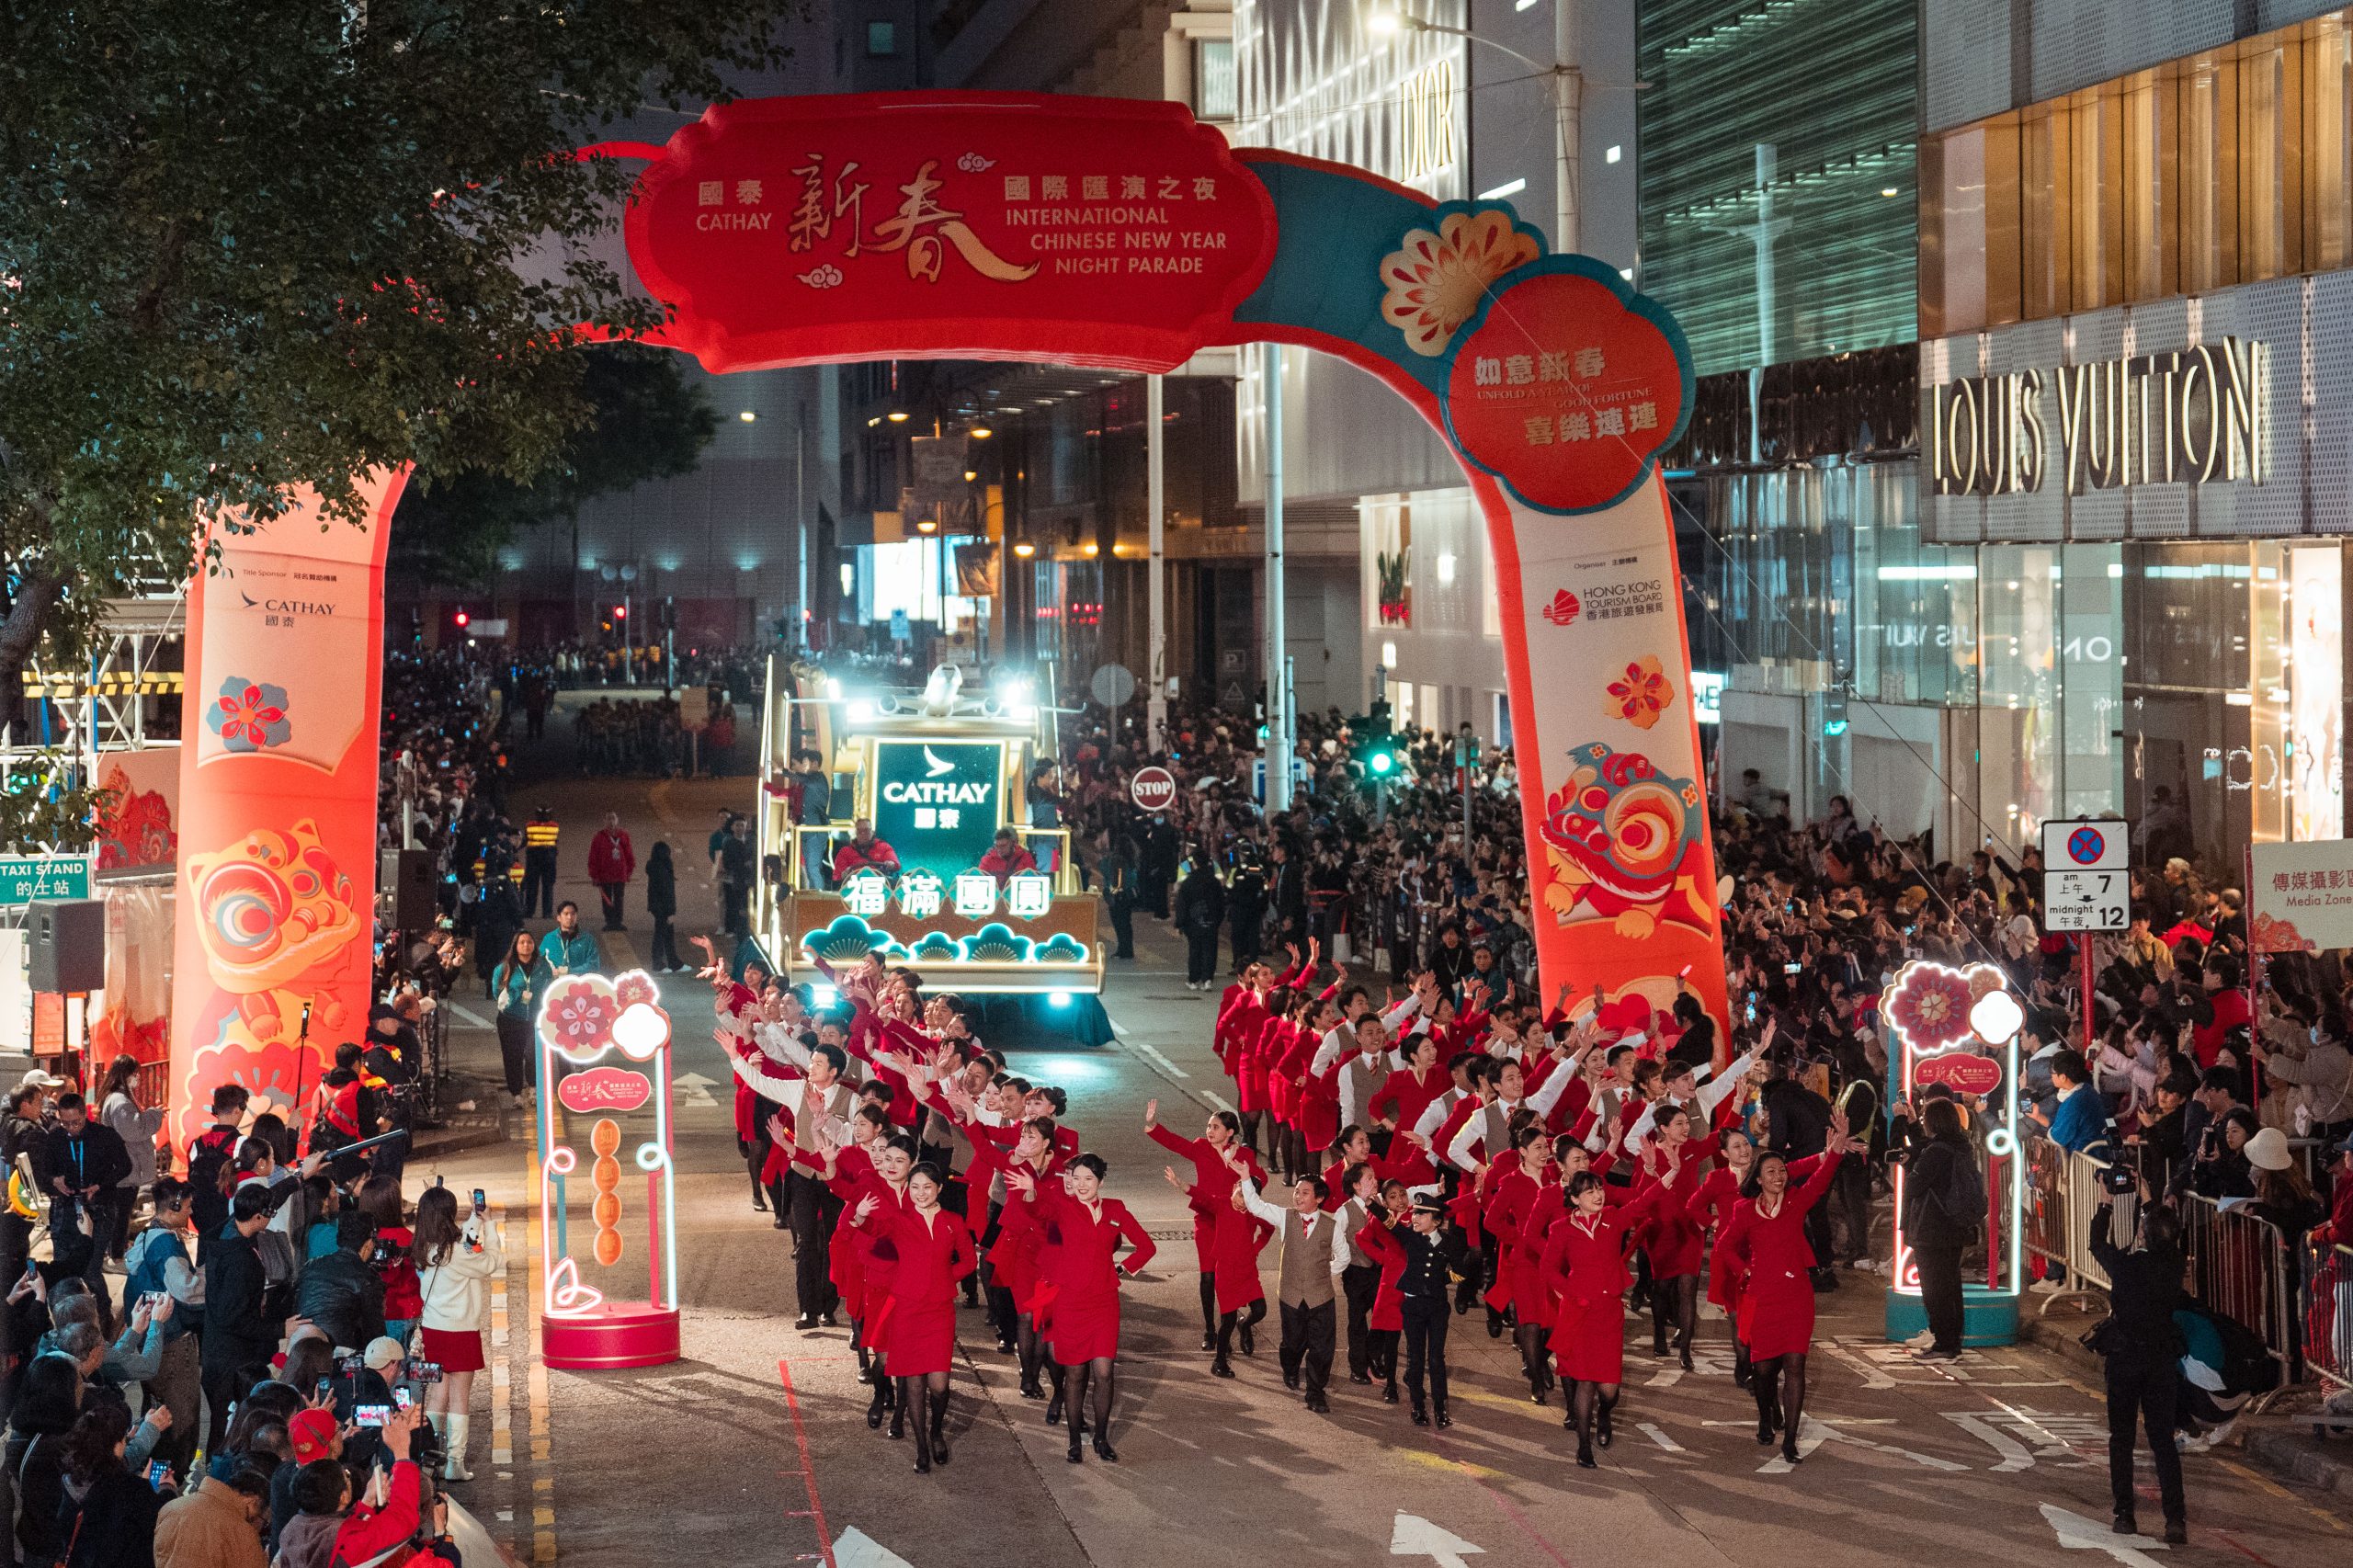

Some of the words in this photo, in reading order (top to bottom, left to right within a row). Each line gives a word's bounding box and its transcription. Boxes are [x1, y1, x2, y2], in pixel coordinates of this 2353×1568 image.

[1401, 59, 1454, 183] DIOR
[699, 179, 763, 207] 國泰
[1005, 175, 1218, 201] 國際匯演之夜
[696, 212, 772, 231] CATHAY
[788, 153, 1040, 283] 新春
[1006, 207, 1169, 226] INTERNATIONAL
[1030, 232, 1117, 250] CHINESE
[1124, 232, 1172, 249] NEW
[1180, 231, 1227, 249] YEAR
[1056, 256, 1120, 274] NIGHT
[1128, 256, 1203, 274] PARADE
[1474, 347, 1606, 386] 如意新春
[1478, 386, 1526, 400] UNFOLD
[1529, 387, 1537, 398] A
[1540, 384, 1575, 397] YEAR
[1553, 395, 1592, 409] GOOD
[1595, 386, 1655, 405] FORTUNE
[1525, 401, 1659, 446] 喜樂連連
[1934, 369, 2042, 496] LOUIS
[2055, 335, 2264, 496] VUITTON
[258, 570, 287, 578] Sponsor
[1574, 561, 1607, 570] Organiser
[1584, 585, 1626, 598] HONG
[1628, 579, 1662, 594] KONG
[265, 599, 336, 615] CATHAY
[1586, 596, 1631, 609] TOURISM
[1632, 592, 1663, 605] BOARD
[1586, 602, 1664, 620] 香港旅遊發展局
[265, 615, 295, 628] 國泰
[883, 781, 992, 803] CATHAY
[1135, 781, 1171, 796] STOP
[915, 808, 960, 829] 國泰
[0, 865, 31, 876] TAXI
[36, 863, 84, 875] STAND
[16, 880, 70, 896] 的士站
[2059, 883, 2084, 894] 上午
[2097, 874, 2111, 893] 7
[844, 874, 1051, 915] 福滿團圓
[2287, 893, 2321, 907] Media
[2325, 893, 2352, 905] Zone
[2050, 904, 2094, 915] midnight
[2099, 906, 2124, 926] 12
[2059, 916, 2085, 927] 午夜
